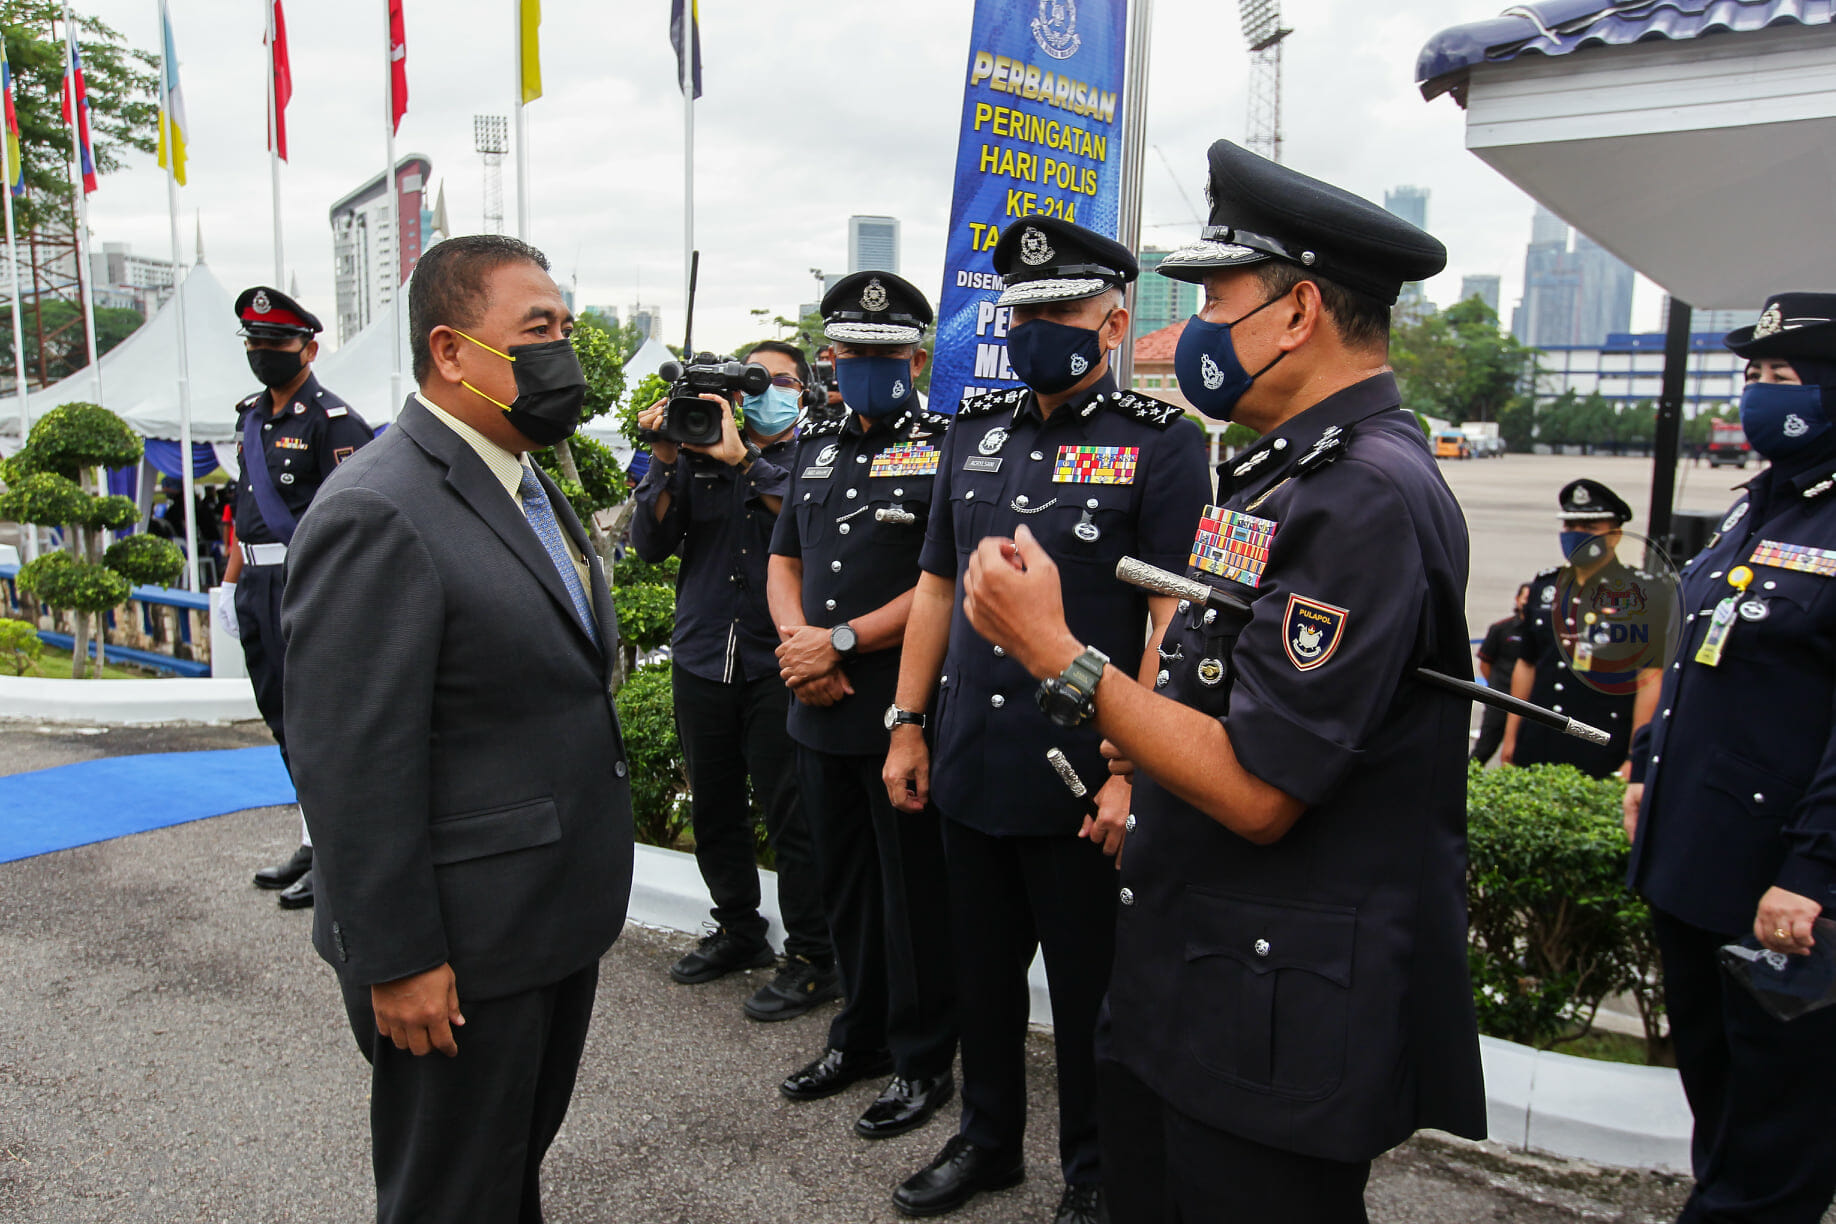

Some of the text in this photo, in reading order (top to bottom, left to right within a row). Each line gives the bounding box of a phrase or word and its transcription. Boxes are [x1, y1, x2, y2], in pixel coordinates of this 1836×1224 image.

[971, 51, 1116, 123] PERBARISAN
[974, 102, 1107, 162] PERINGATAN
[979, 144, 1098, 196] HARI POLIS
[1006, 189, 1076, 223] KE-214
[969, 222, 1000, 252] TA
[956, 270, 1008, 291] DISEM
[976, 300, 1014, 338] PE
[974, 343, 1020, 381] ME
[1299, 608, 1332, 625] PULAPOL
